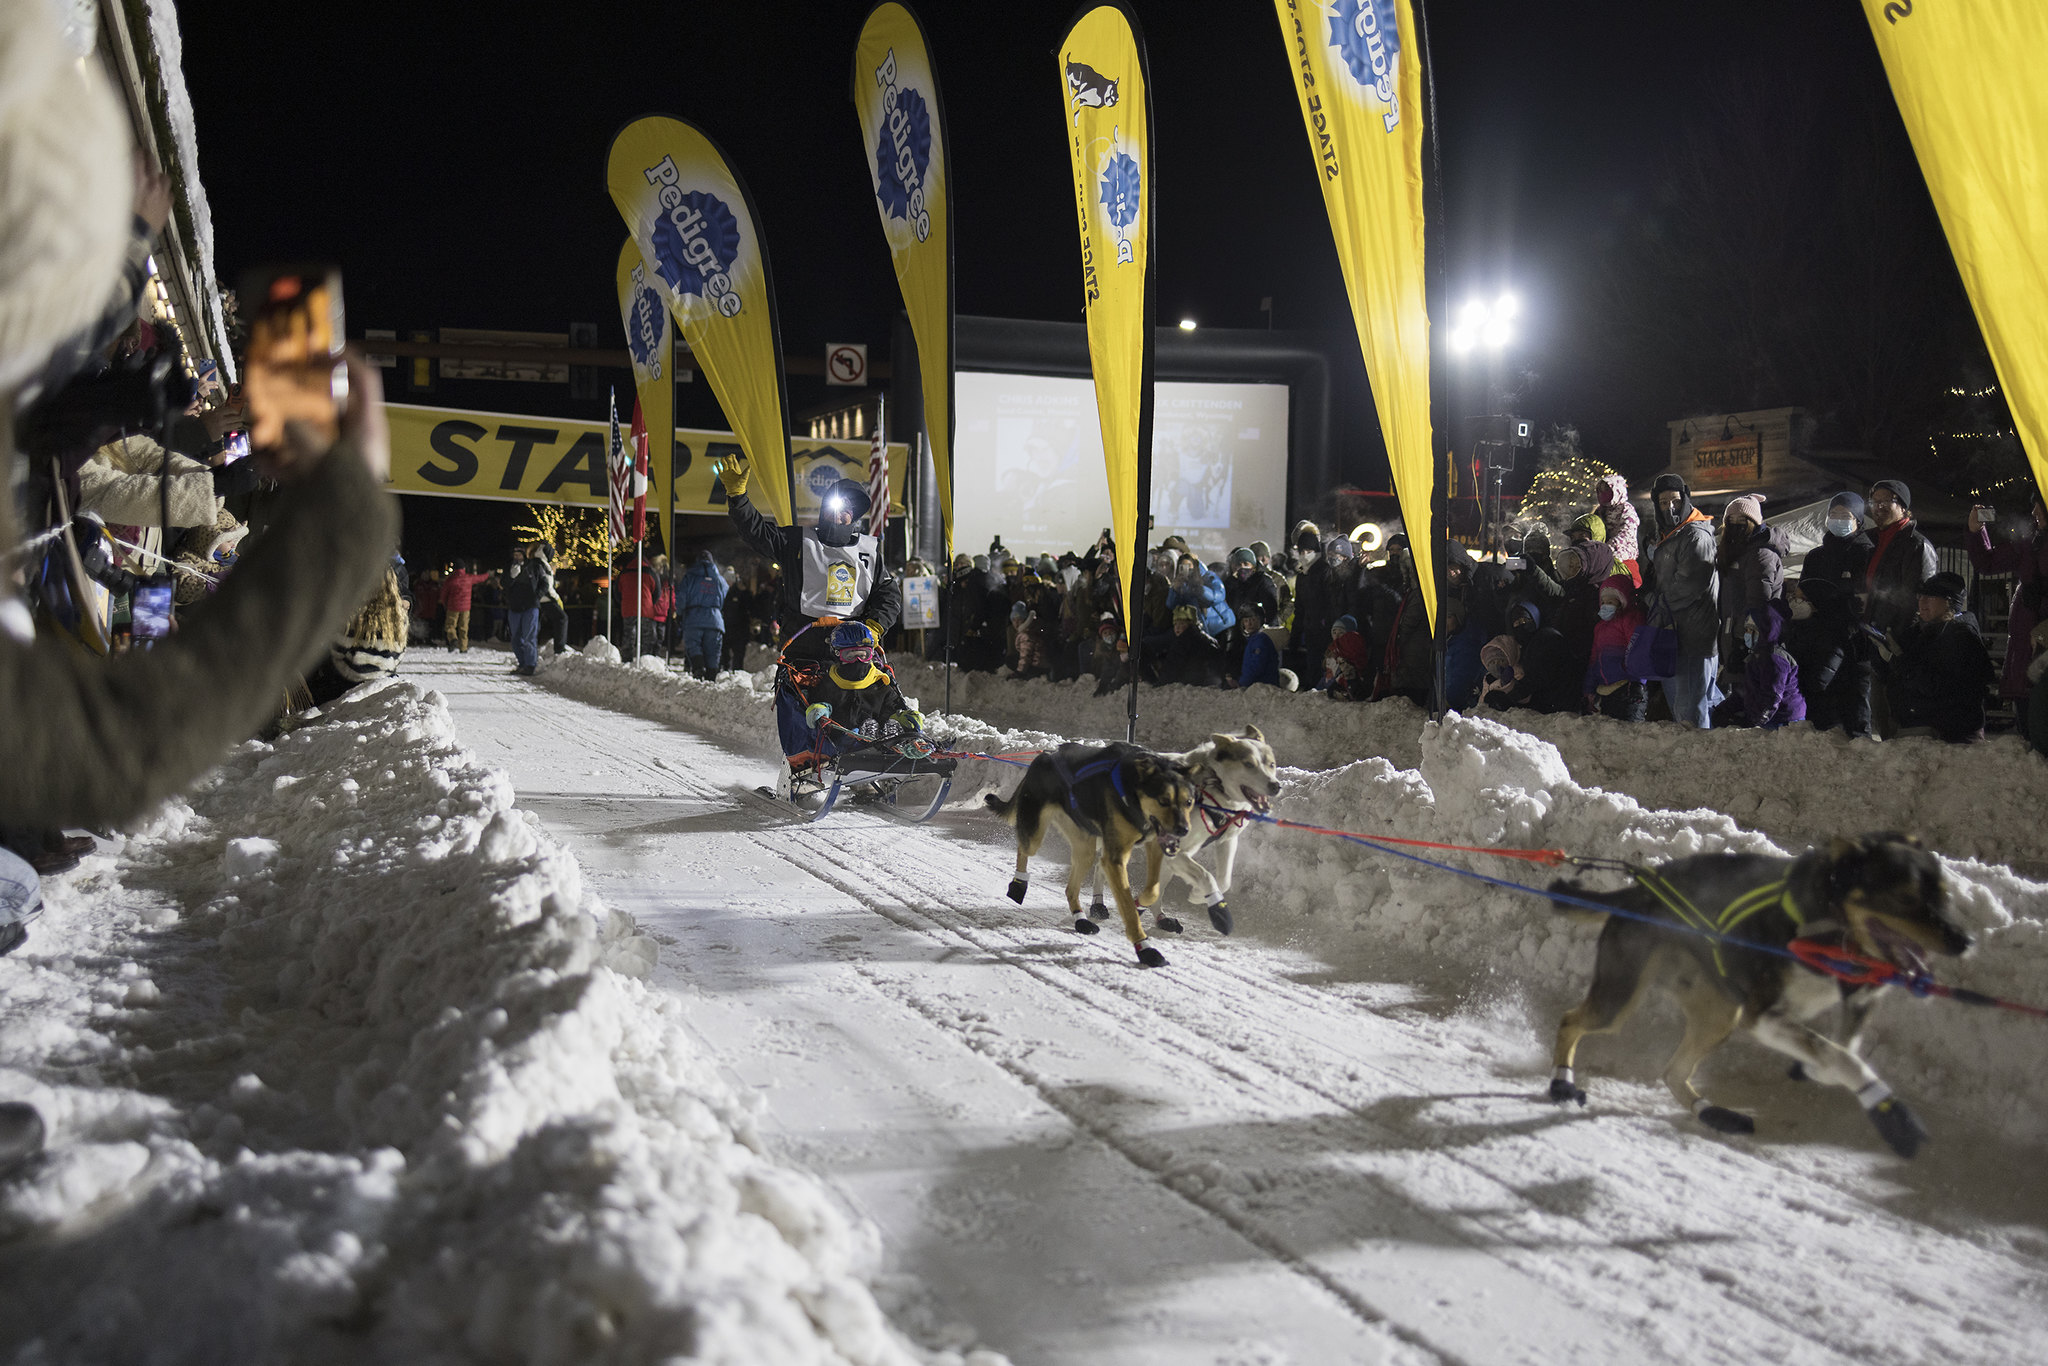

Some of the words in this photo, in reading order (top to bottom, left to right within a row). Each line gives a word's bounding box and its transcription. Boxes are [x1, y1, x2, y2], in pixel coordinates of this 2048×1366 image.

[875, 47, 931, 243] Pedigree
[644, 153, 742, 318] Pedigree
[631, 258, 662, 381] Pedigree
[1696, 449, 1727, 468] STAGE
[1729, 446, 1755, 466] STOP
